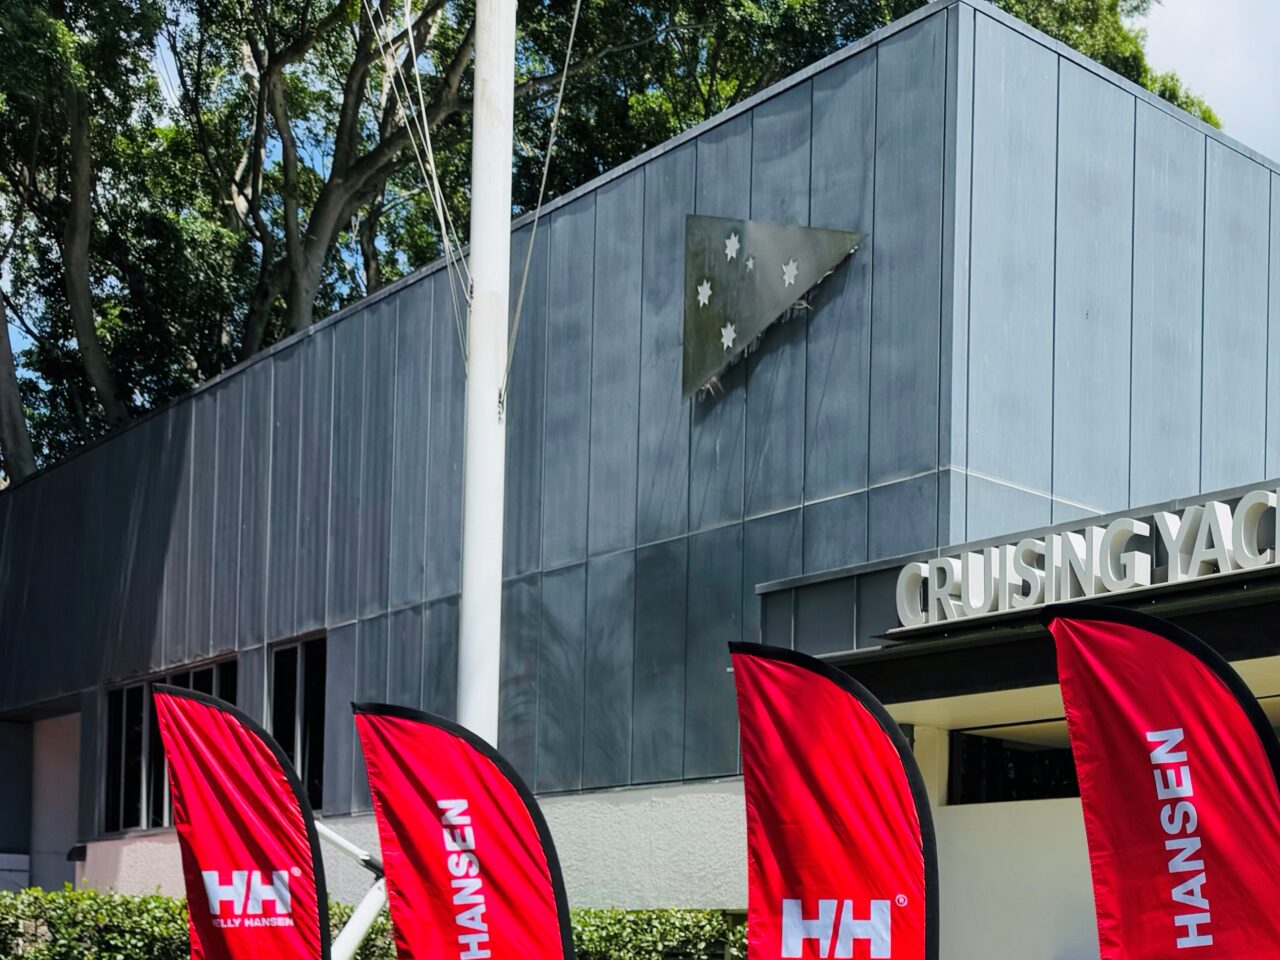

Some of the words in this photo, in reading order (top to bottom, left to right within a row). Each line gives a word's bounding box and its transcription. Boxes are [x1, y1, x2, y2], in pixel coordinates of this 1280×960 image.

[896, 517, 1151, 628] CRUISING
[437, 798, 492, 960] HANSEN
[1146, 727, 1214, 947] HANSEN
[211, 918, 242, 928] ELLY
[244, 916, 295, 927] HANSEN
